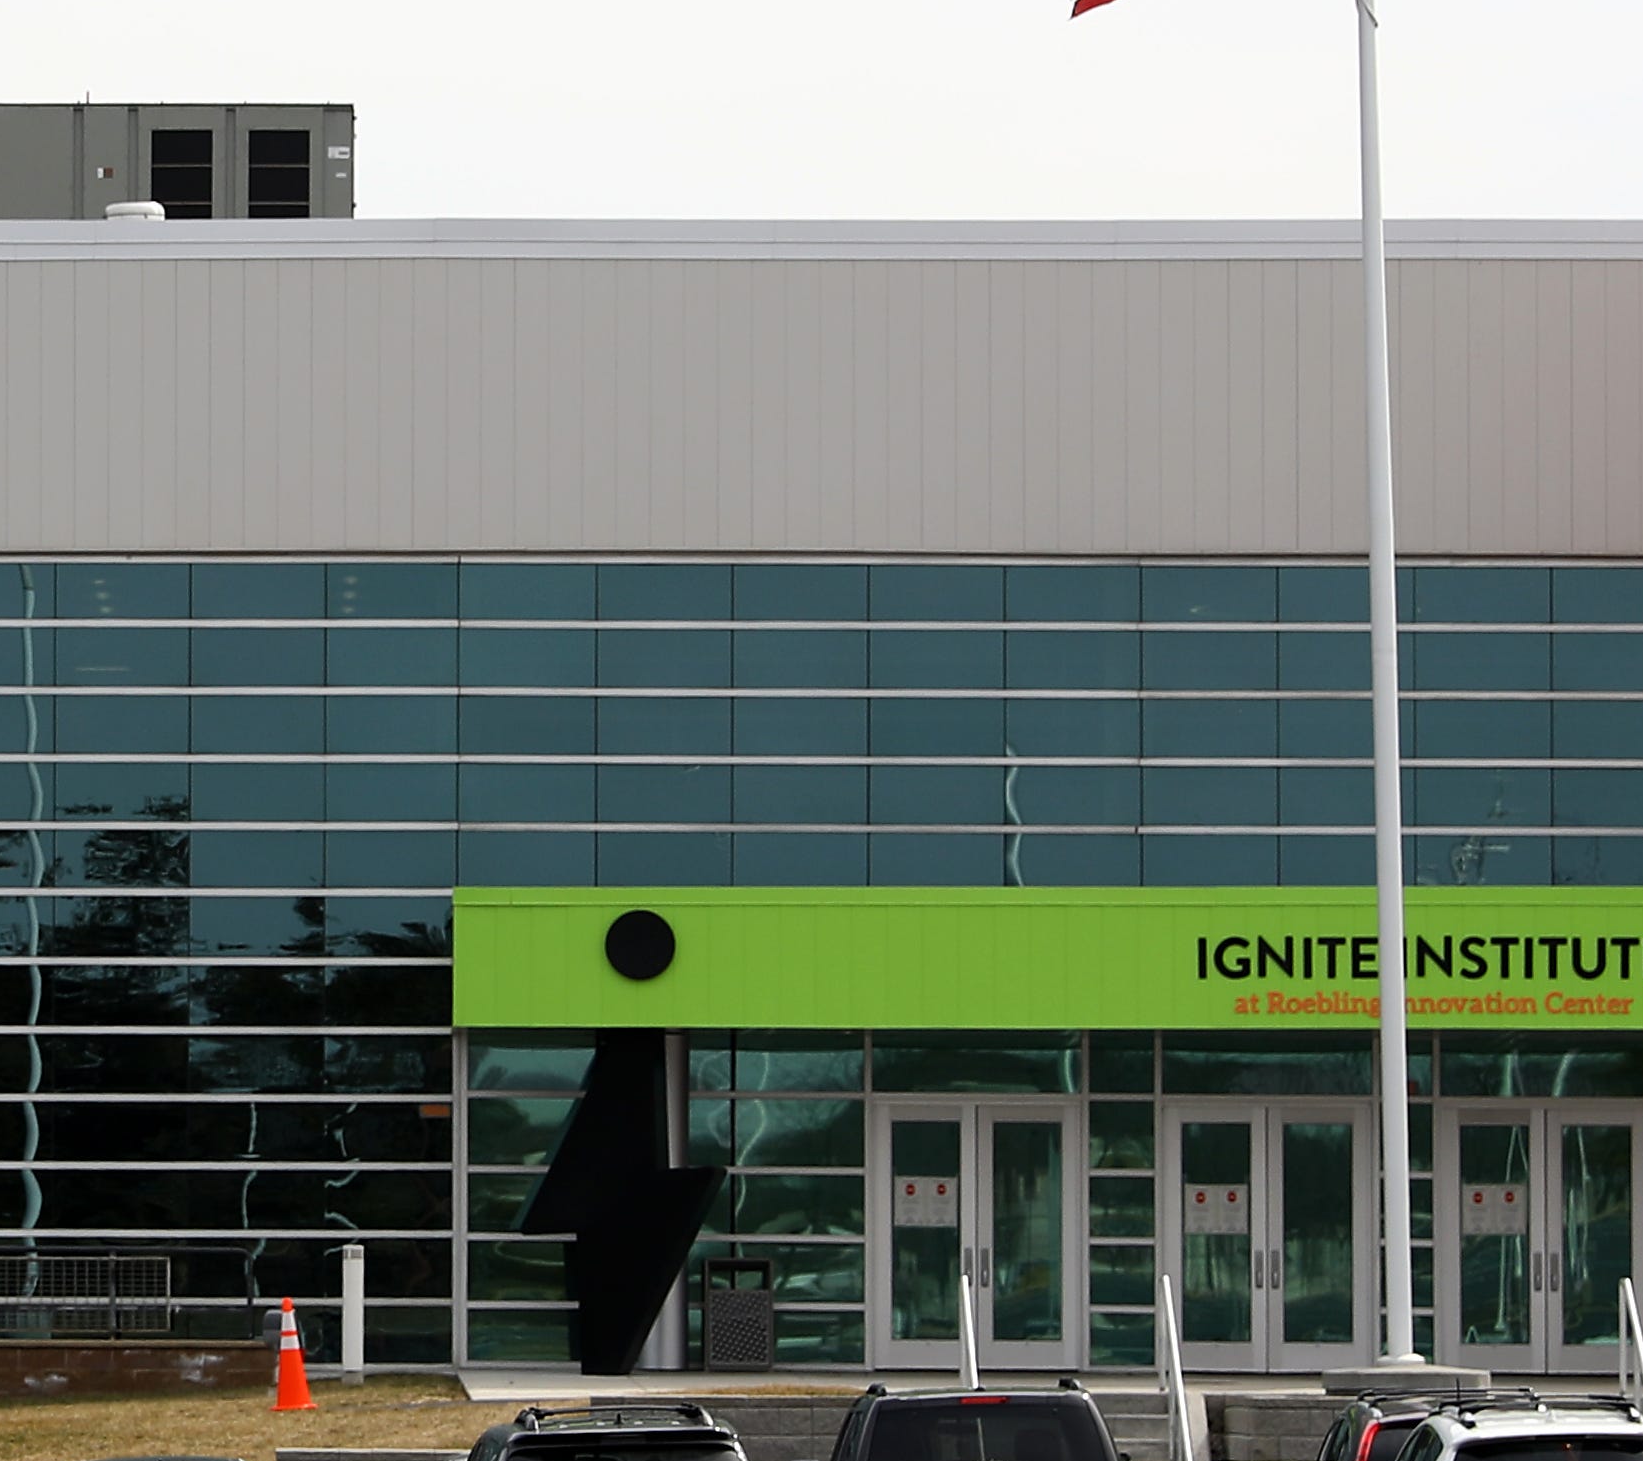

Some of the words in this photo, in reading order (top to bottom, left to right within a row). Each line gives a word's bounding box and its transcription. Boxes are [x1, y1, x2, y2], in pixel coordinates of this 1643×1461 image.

[1197, 935, 1379, 980] IGNITE
[1234, 994, 1260, 1014] at
[1267, 990, 1382, 1019] Roebling
[1403, 991, 1538, 1015] nnovation
[1543, 990, 1634, 1015] Center
